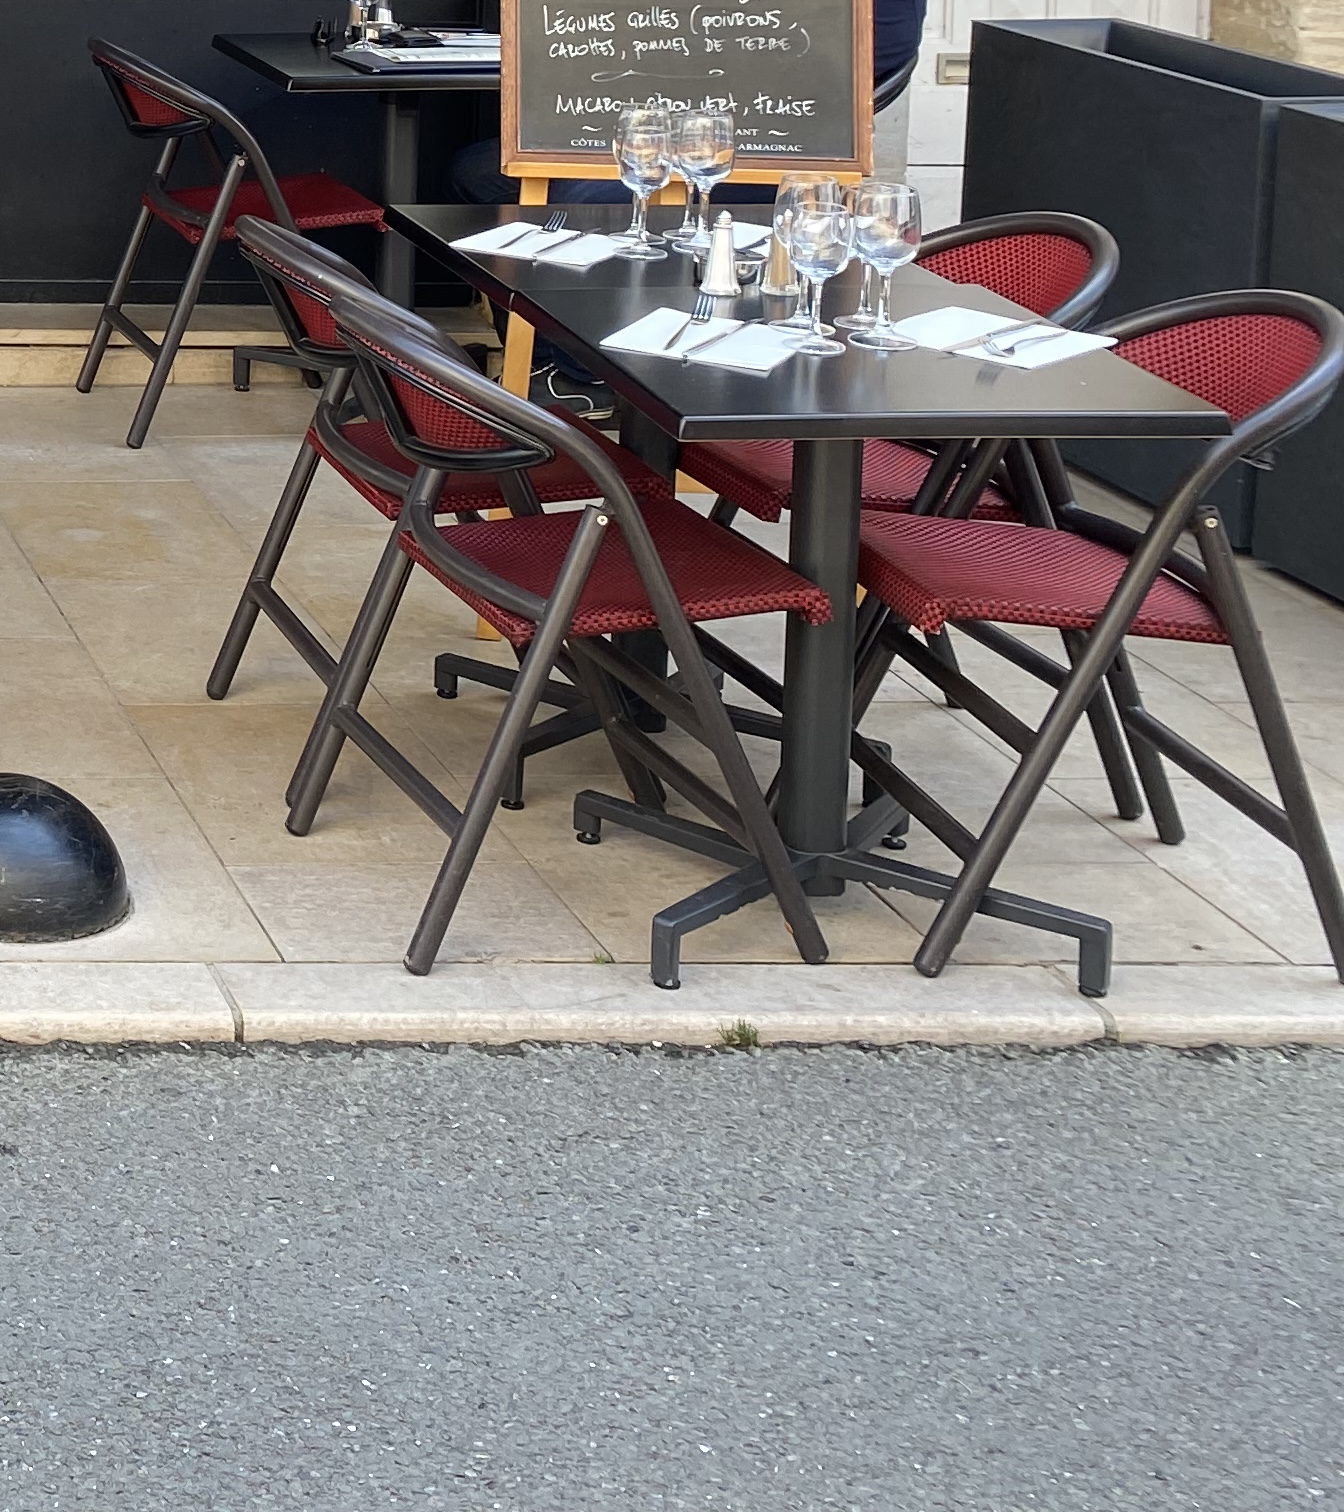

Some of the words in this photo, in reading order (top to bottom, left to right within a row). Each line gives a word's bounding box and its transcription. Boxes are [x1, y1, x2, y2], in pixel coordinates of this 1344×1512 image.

[705, 39, 724, 52] DE
[735, 128, 759, 137] ANT
[570, 137, 606, 147] CÔTES
[738, 143, 803, 153] ARMAGNAC
